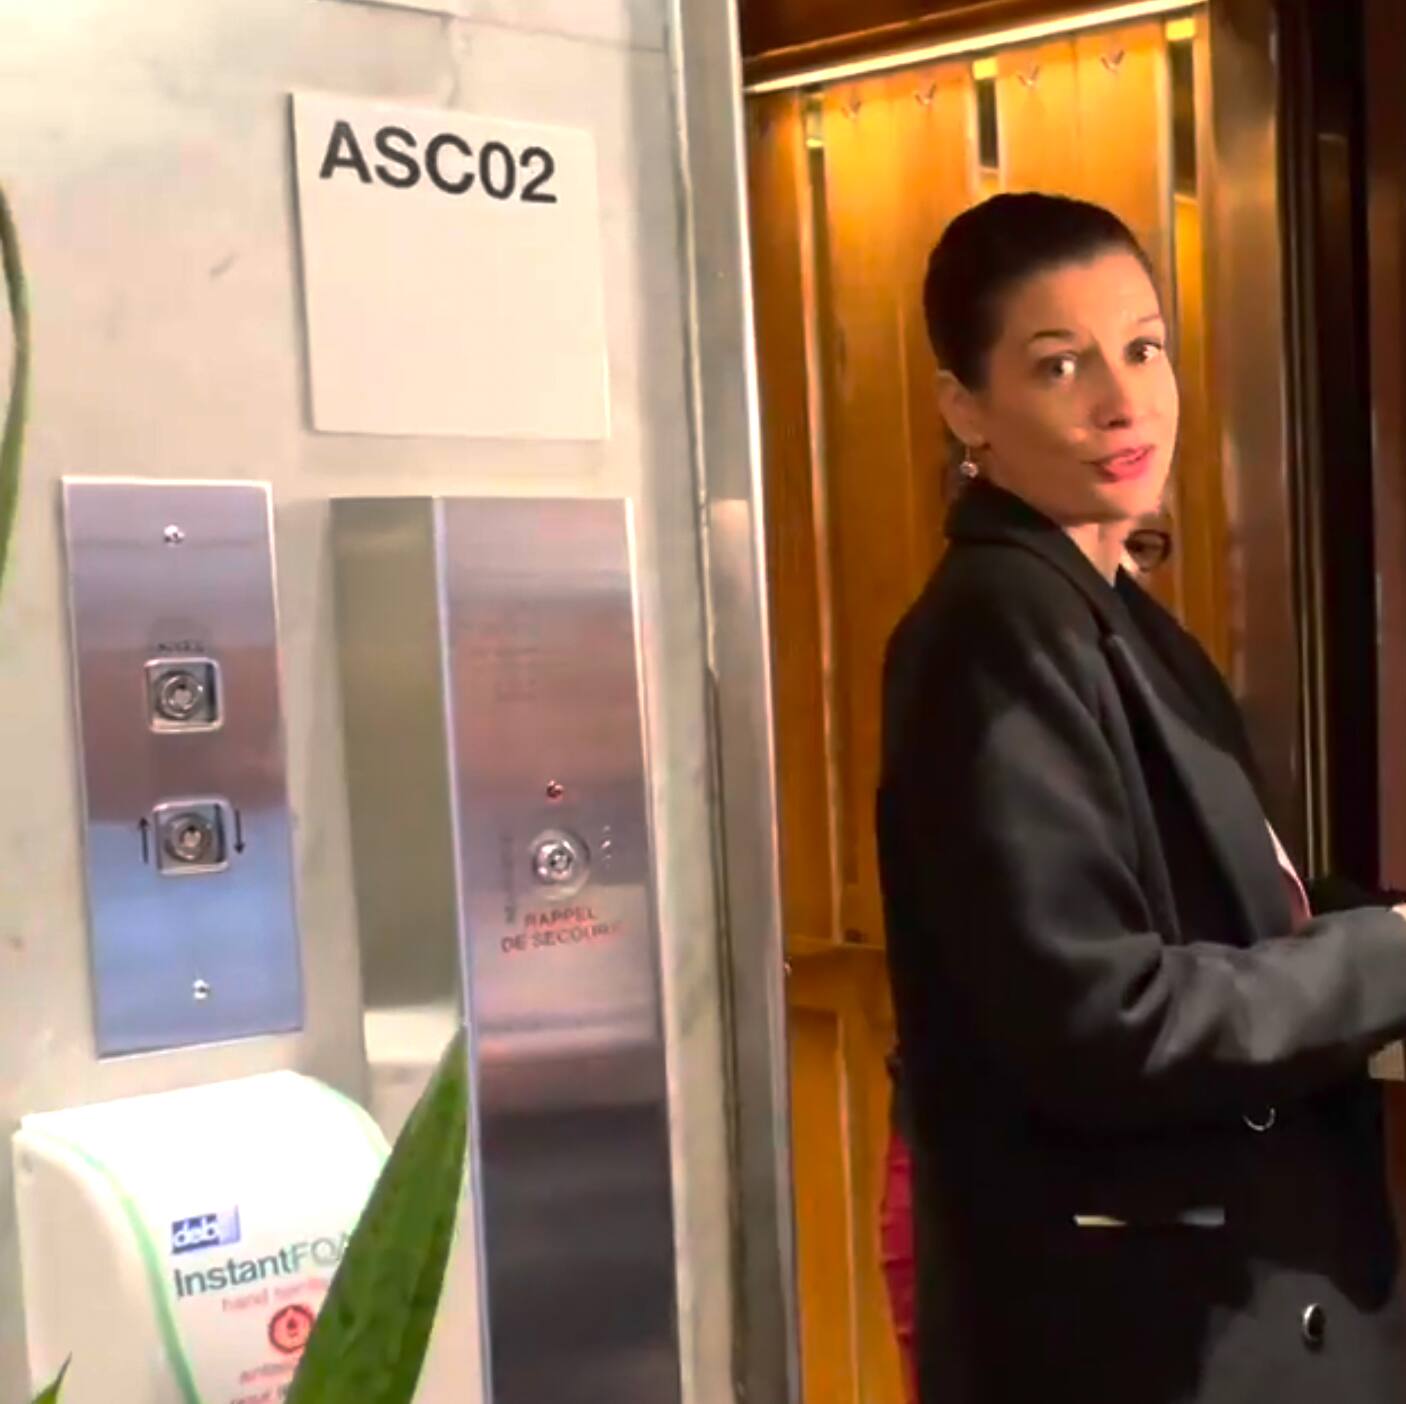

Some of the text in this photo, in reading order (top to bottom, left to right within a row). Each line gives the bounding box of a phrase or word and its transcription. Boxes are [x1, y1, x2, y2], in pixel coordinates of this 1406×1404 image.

[318, 119, 558, 203] ASC02
[524, 906, 597, 928] RAPPEL
[500, 934, 527, 952] DE
